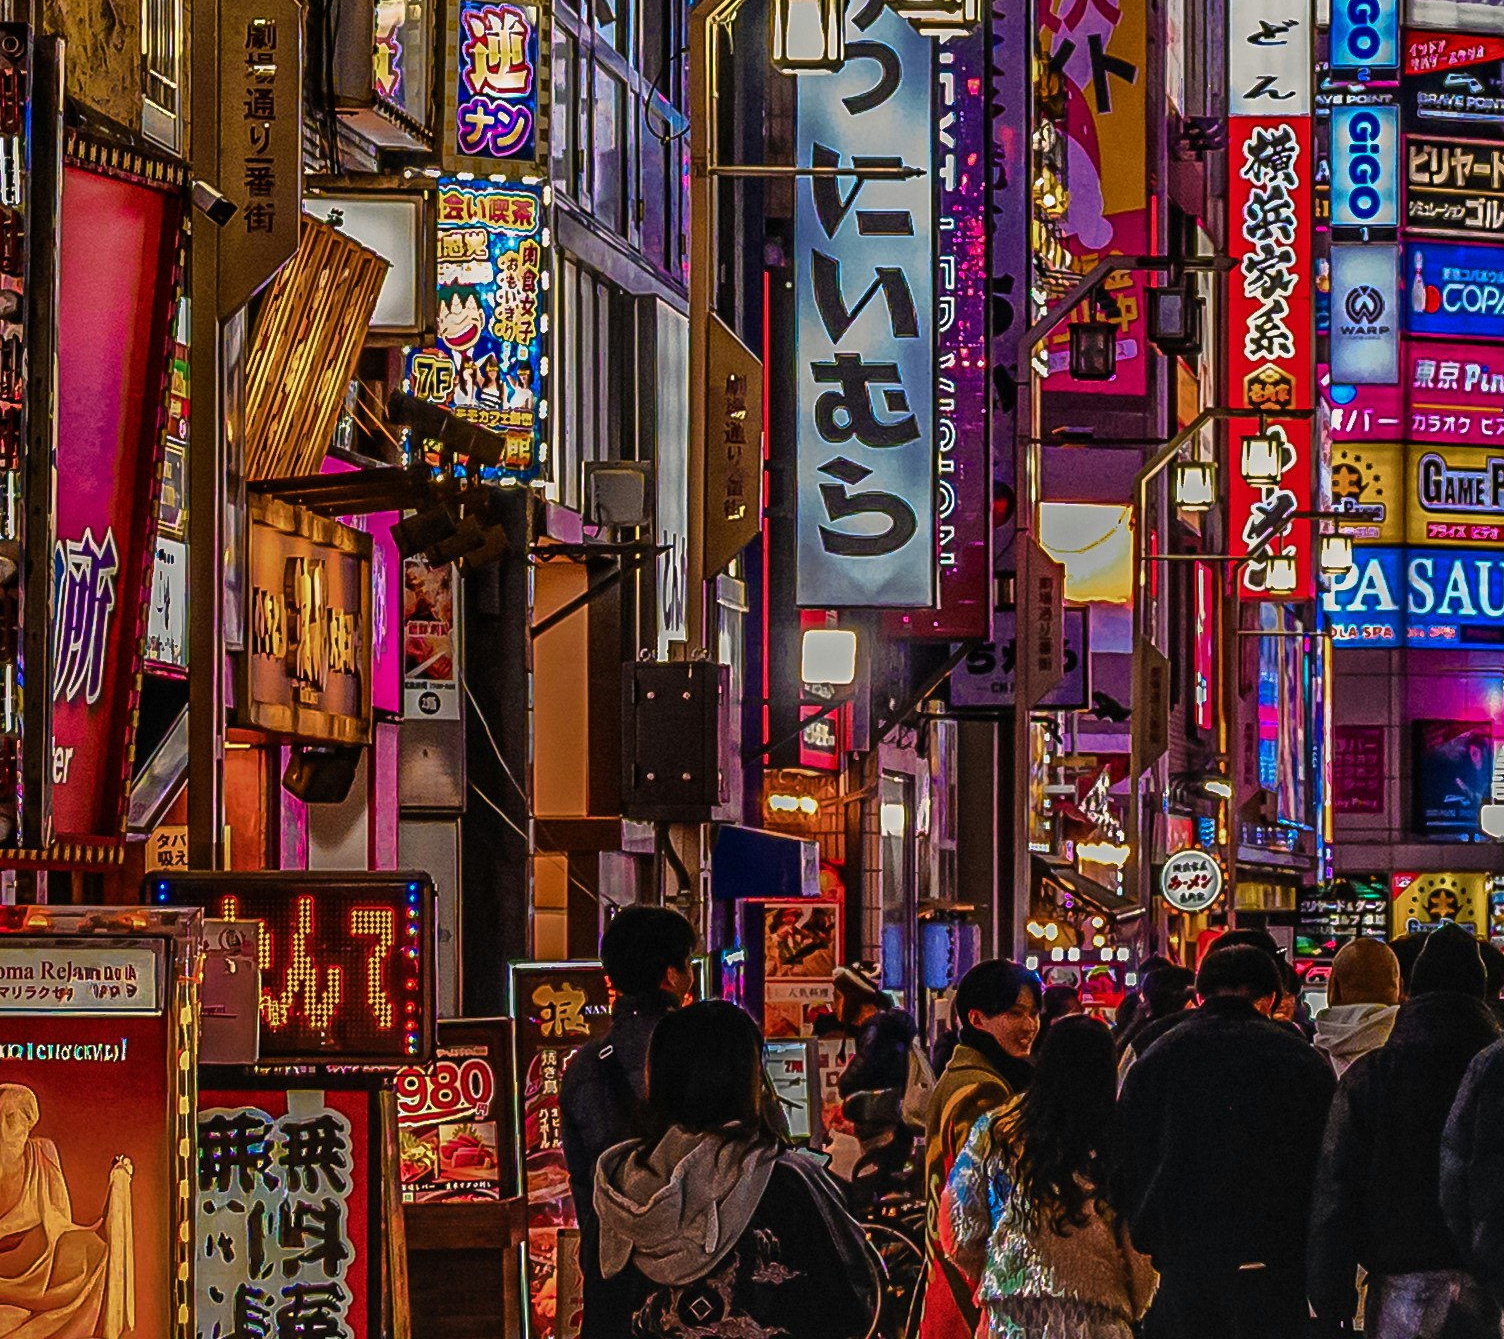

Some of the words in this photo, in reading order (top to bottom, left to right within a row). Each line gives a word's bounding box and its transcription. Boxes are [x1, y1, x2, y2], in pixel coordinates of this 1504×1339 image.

[243, 17, 277, 234] 劇場通り一番街
[1347, 111, 1381, 221] GiGO
[1241, 126, 1299, 363] 横浜家系
[1340, 325, 1390, 336] WARP
[413, 359, 454, 399] 7F
[1413, 359, 1461, 392] 東京
